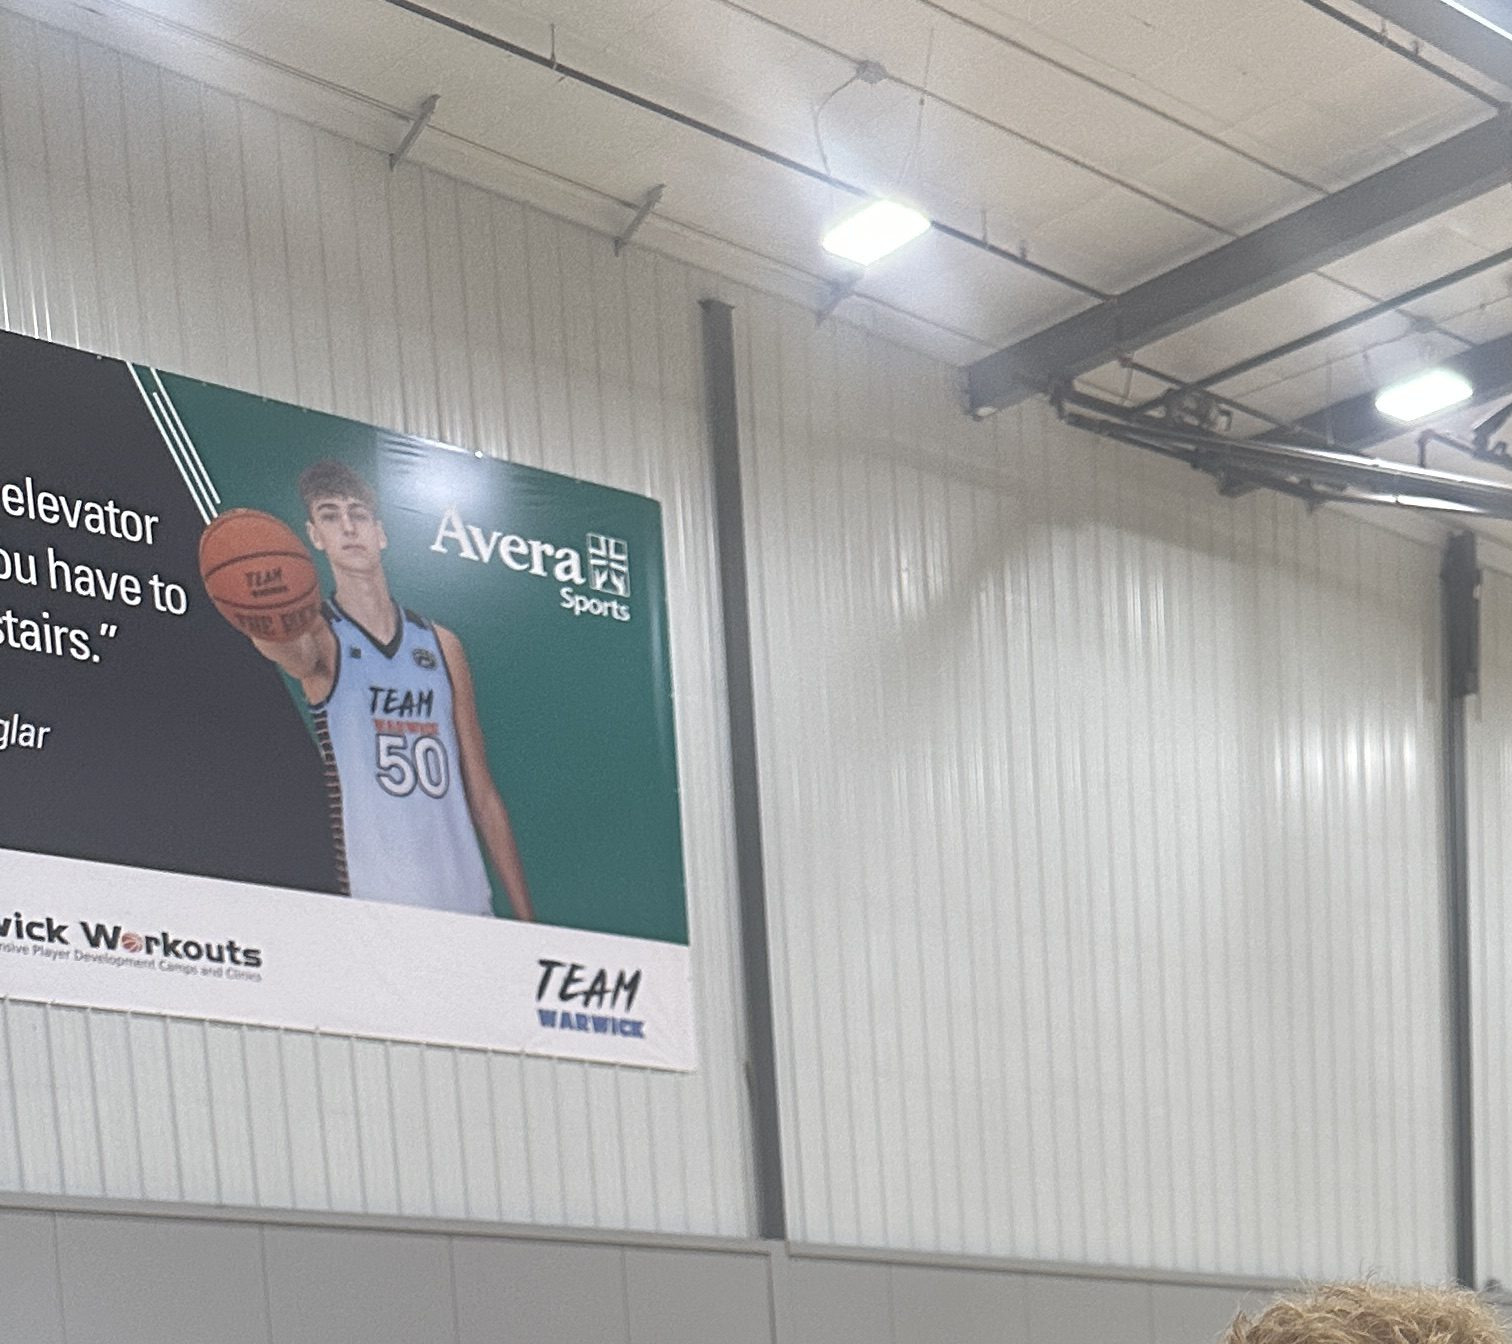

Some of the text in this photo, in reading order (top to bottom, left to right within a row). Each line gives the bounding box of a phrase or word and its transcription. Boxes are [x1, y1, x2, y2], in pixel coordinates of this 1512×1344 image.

[1, 476, 160, 545] elevator
[430, 504, 586, 585] Avera
[47, 547, 143, 606] have
[148, 573, 188, 616] to
[560, 586, 631, 622] Sports
[369, 687, 434, 717] TEAM
[376, 733, 450, 799] 50
[537, 958, 642, 1013] TEAM
[537, 1009, 646, 1039] WARWICK
